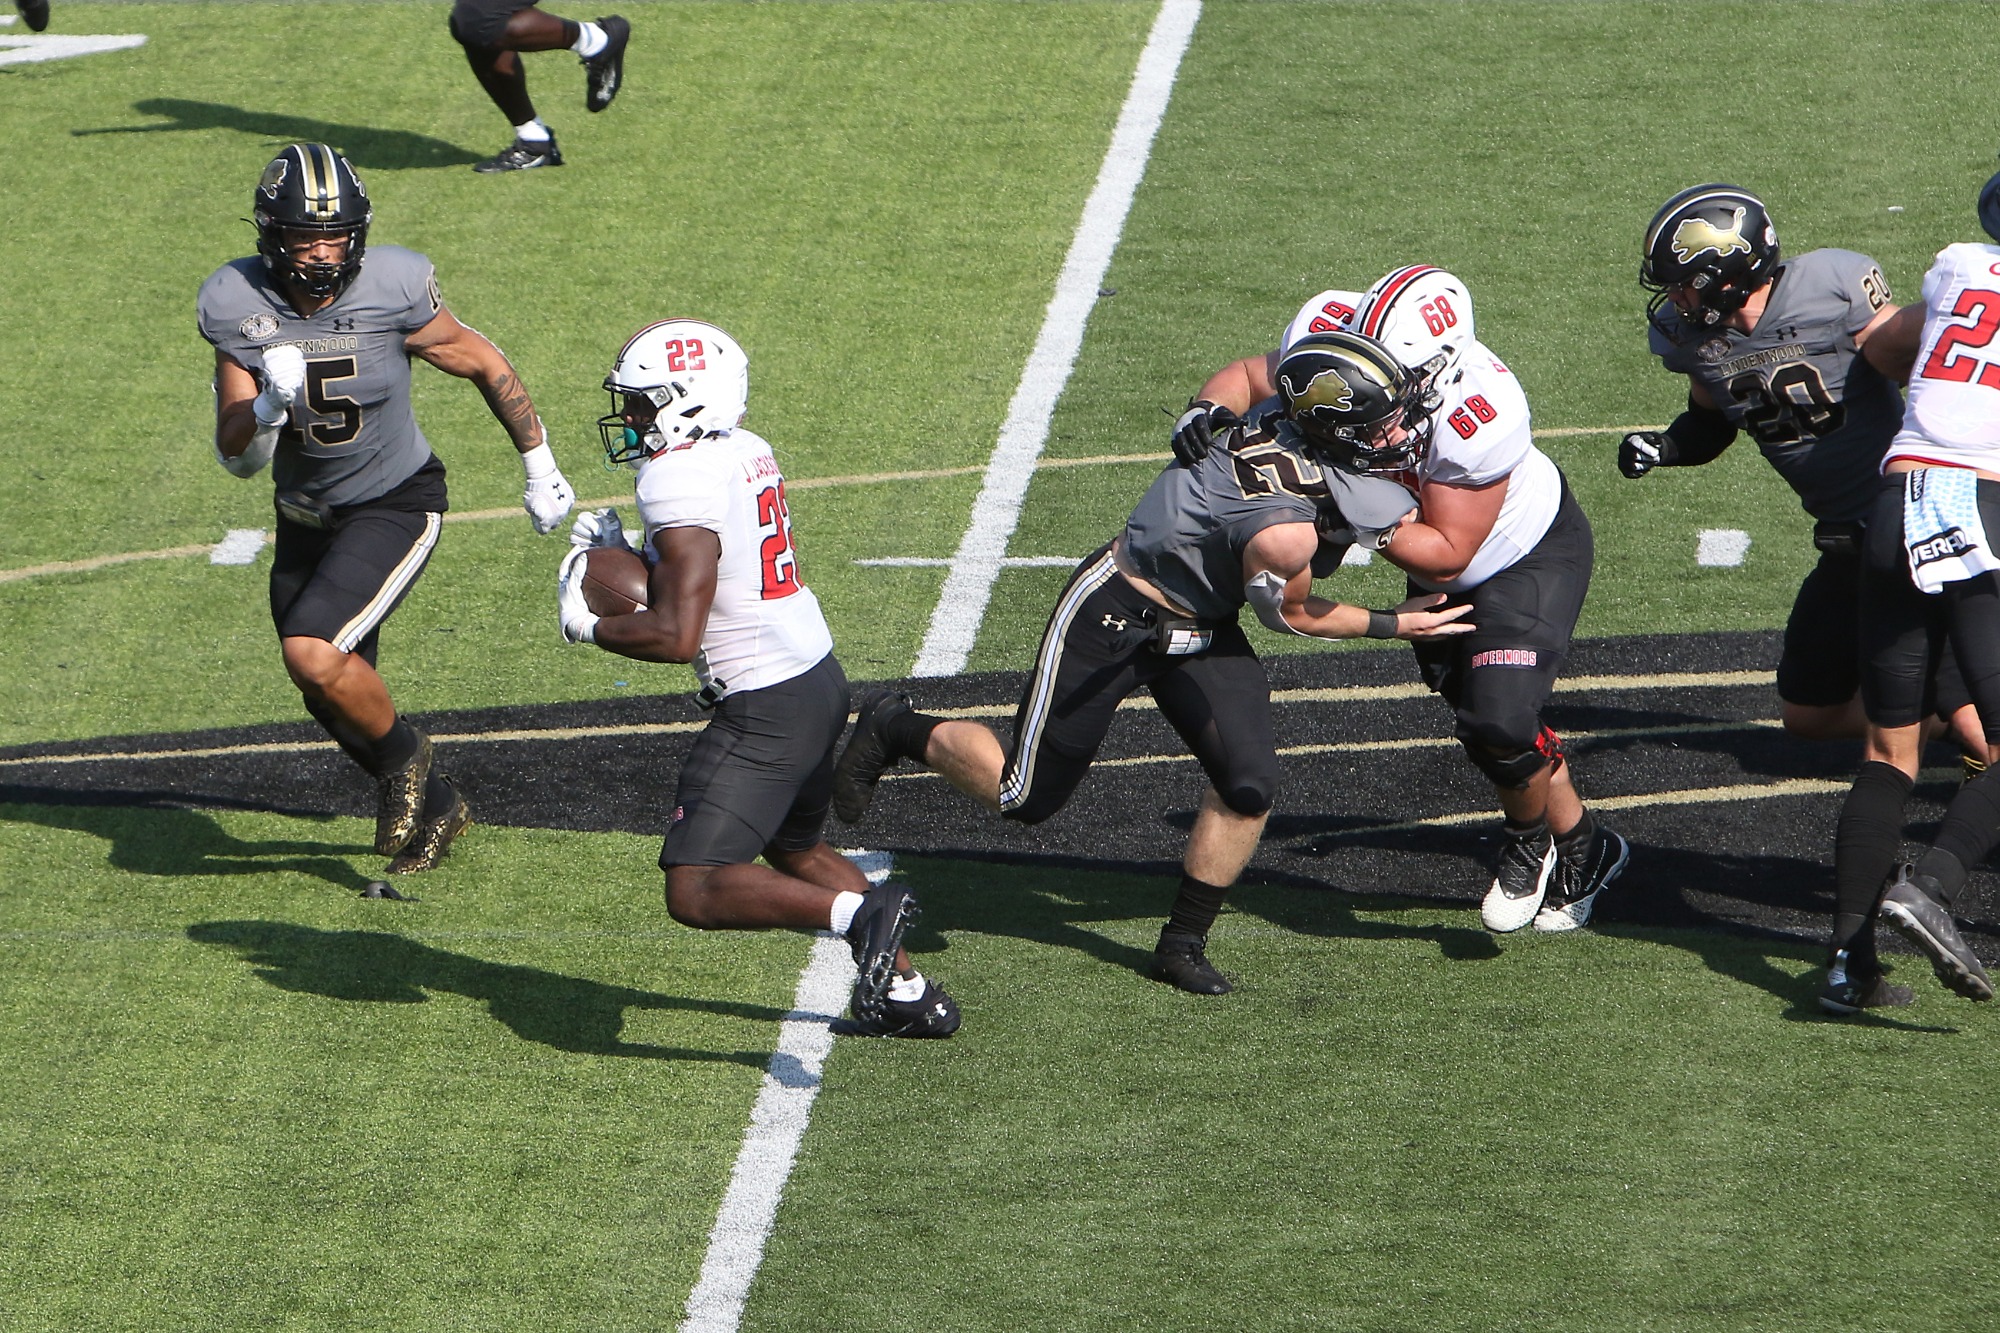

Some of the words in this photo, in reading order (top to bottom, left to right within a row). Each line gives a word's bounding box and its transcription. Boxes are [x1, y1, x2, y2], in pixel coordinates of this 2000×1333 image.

[1861, 265, 1893, 314] 20
[1419, 295, 1458, 337] 68
[665, 338, 706, 372] 22
[1720, 343, 1807, 376] LINDENWOOD
[1921, 288, 2000, 390] 2
[1448, 394, 1497, 440] 68
[1728, 360, 1847, 445] 20
[1472, 649, 1537, 669] GOVERNORS
